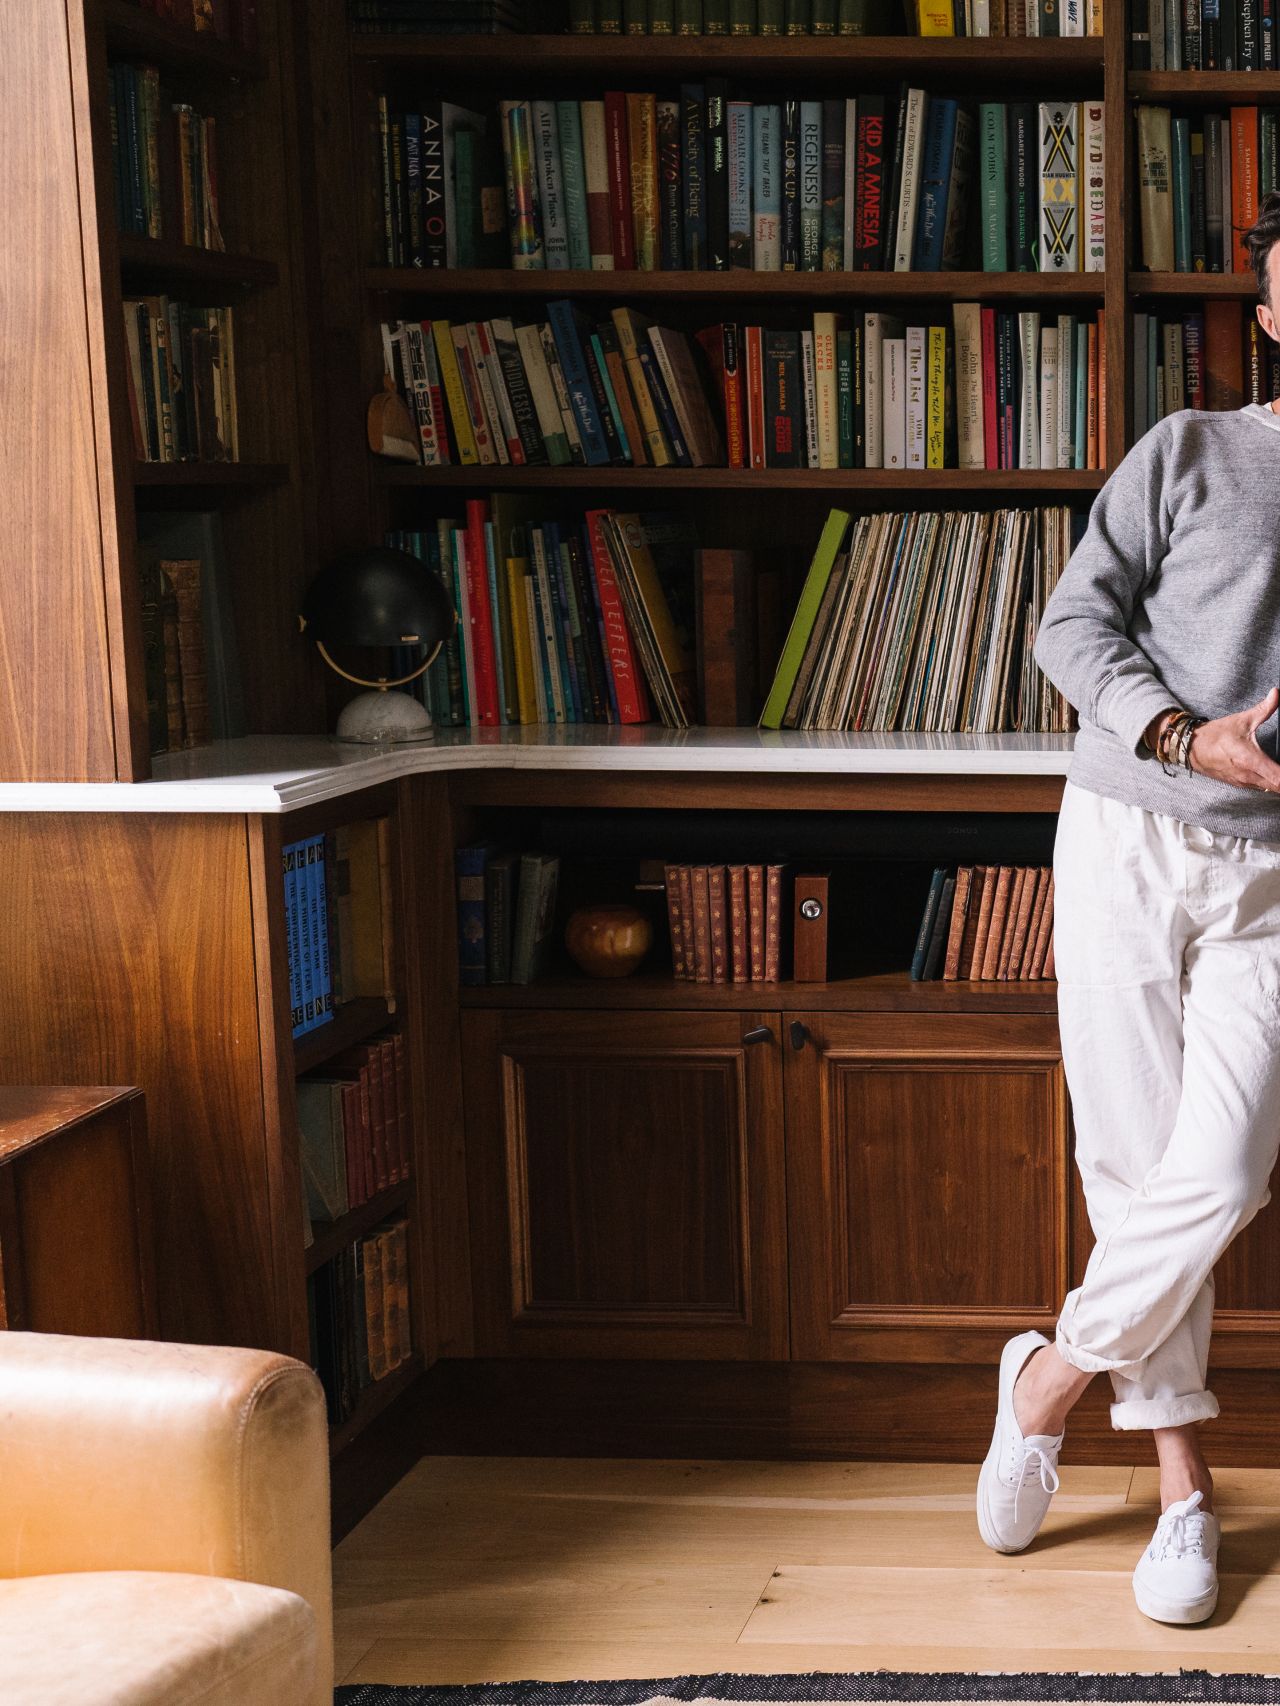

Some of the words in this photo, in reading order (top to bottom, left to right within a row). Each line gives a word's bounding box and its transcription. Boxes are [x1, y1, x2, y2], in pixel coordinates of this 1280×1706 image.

[1243, 41, 1253, 59] Fry
[540, 110, 552, 127] All
[866, 115, 883, 147] KID
[542, 130, 553, 147] the
[543, 151, 555, 190] Broken
[805, 124, 817, 203] REGENESIS
[865, 153, 881, 167] A
[547, 193, 558, 227] Places
[863, 173, 880, 248] MNESIA
[1185, 324, 1198, 354] JOHN
[909, 347, 921, 372] The
[960, 345, 969, 374] Boyne
[970, 352, 978, 374] John
[504, 360, 532, 420] MIDDLESEX
[1186, 358, 1199, 393] GREEN
[909, 379, 921, 403] List
[605, 599, 629, 679] JEFFERS
[291, 903, 300, 967] CONFIDENTIAL
[301, 908, 310, 948] MINISTRY
[322, 928, 328, 939] IN
[303, 952, 310, 964] OF
[294, 972, 302, 1002] AGENT
[304, 968, 312, 991] FEAR
